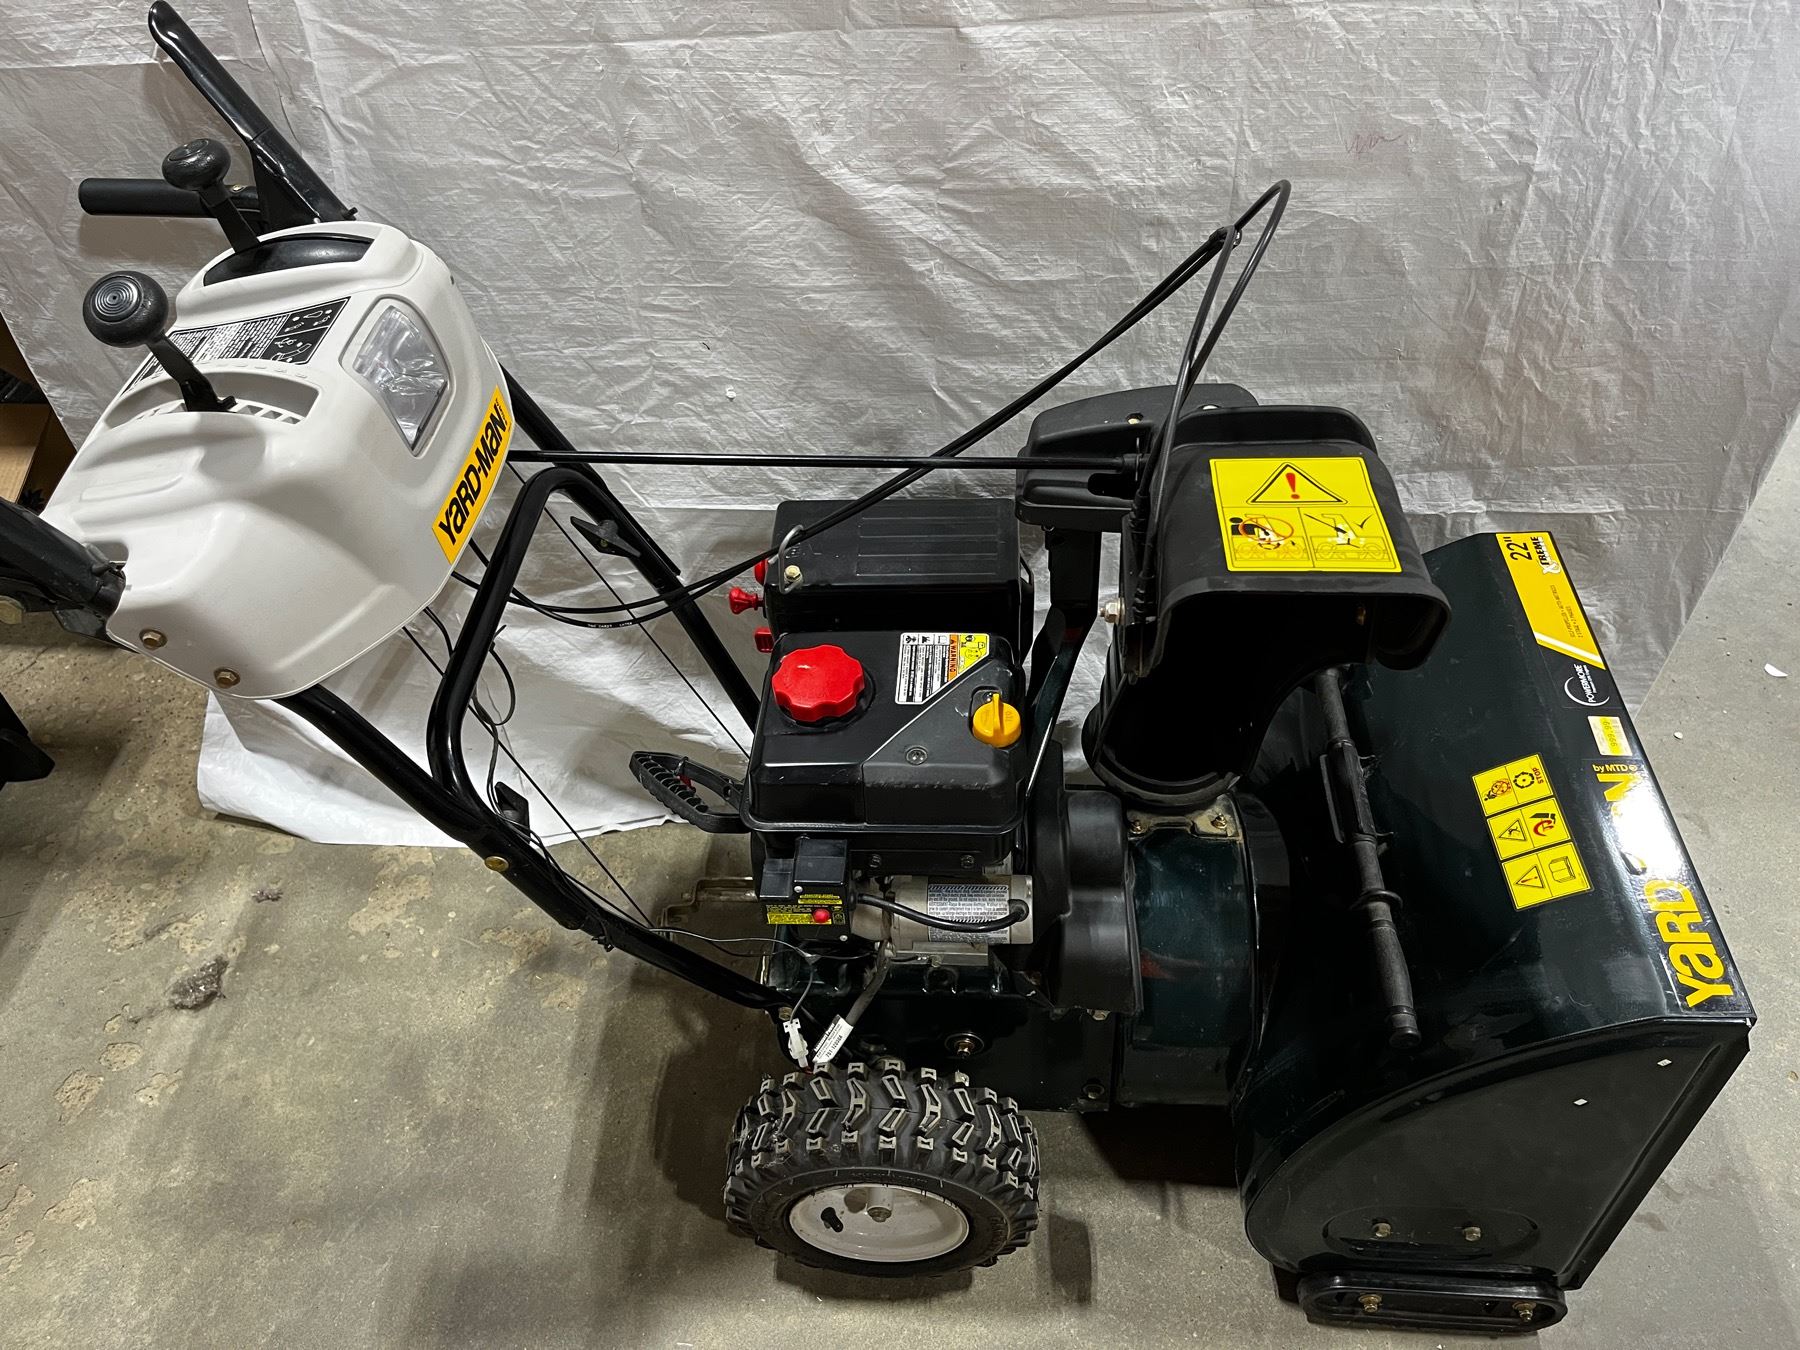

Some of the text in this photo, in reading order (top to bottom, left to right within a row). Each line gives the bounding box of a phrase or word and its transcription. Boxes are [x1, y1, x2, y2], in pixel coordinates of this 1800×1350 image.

[949, 645, 957, 673] WARNING
[1573, 663, 1597, 703] POWERMORE
[1532, 767, 1544, 785] STOP
[1592, 764, 1605, 773] by
